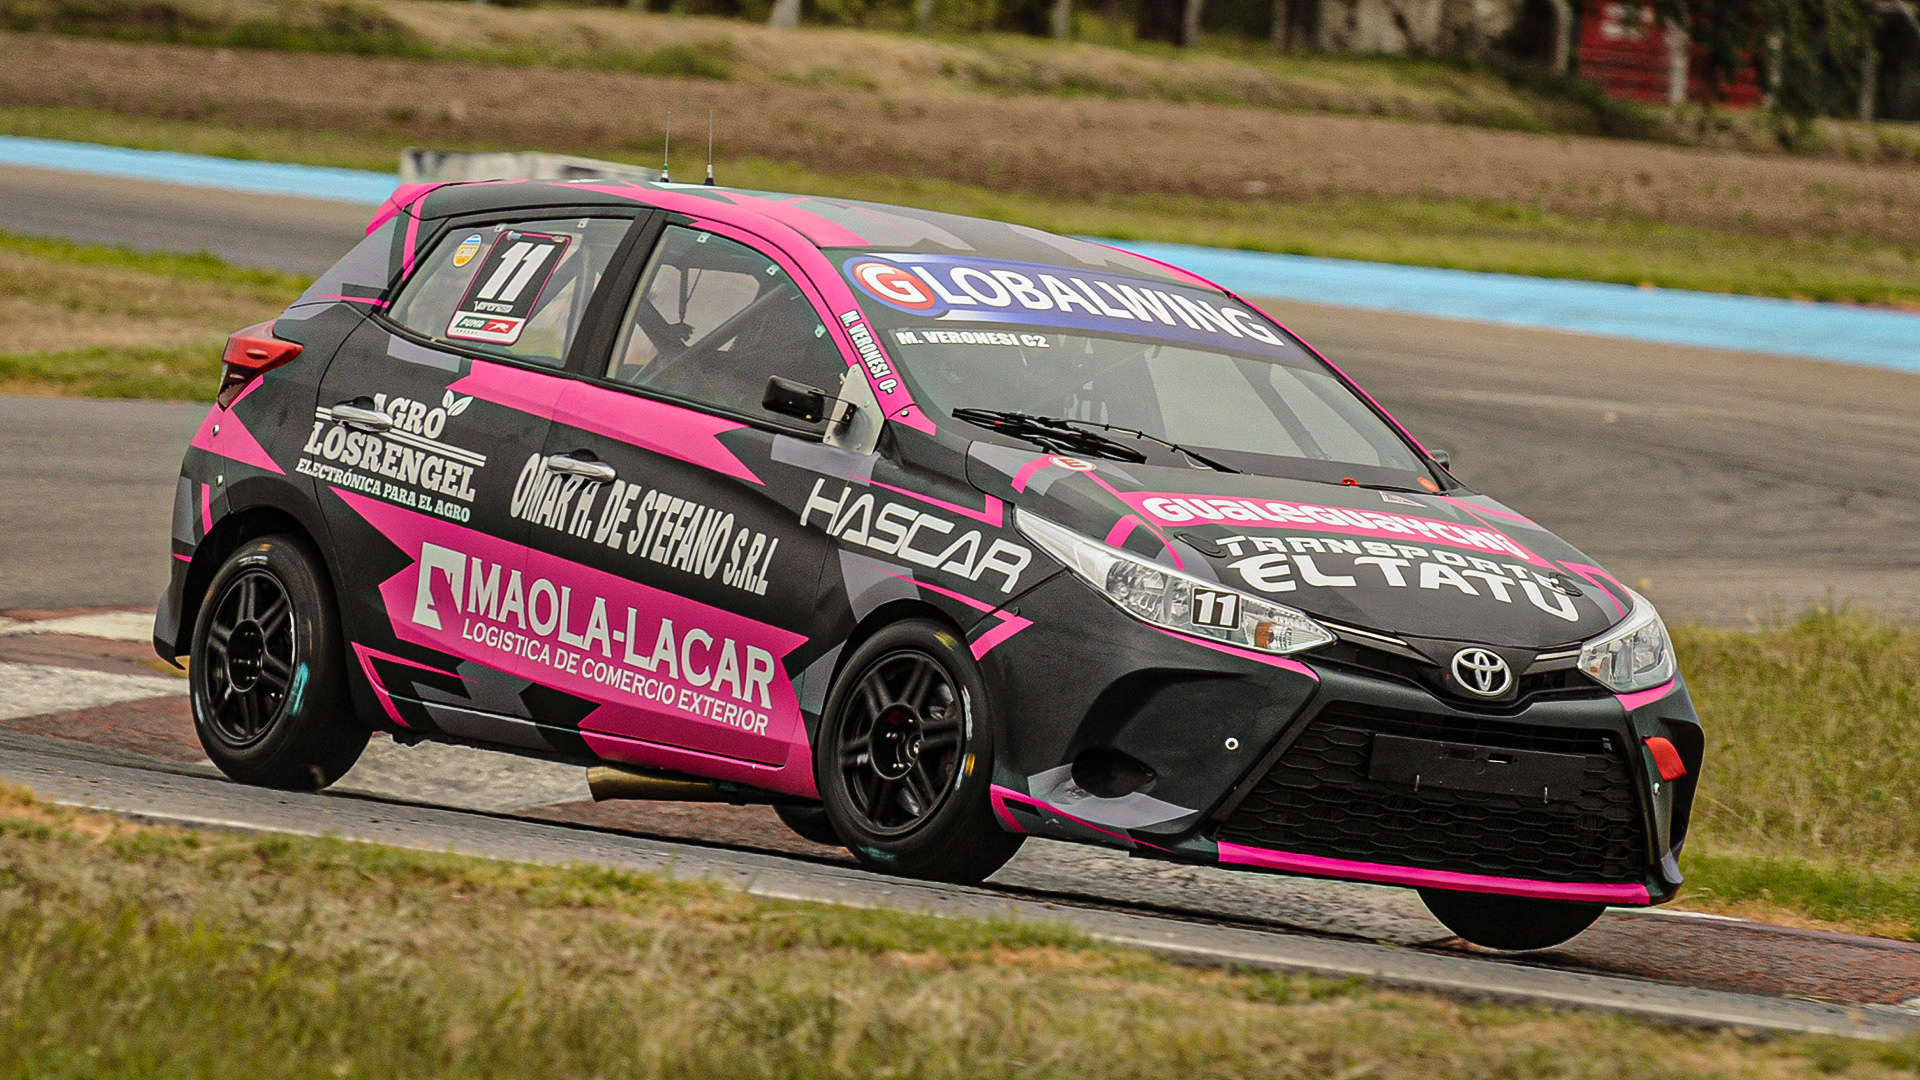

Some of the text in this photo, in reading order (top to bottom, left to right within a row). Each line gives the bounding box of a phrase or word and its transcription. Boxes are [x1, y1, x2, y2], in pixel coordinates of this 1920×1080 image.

[477, 241, 555, 302] 11
[459, 318, 486, 329] PUMA
[839, 310, 862, 328] M.
[861, 263, 1285, 347] GLOBALWING
[848, 322, 892, 380] VERONESI
[895, 331, 1050, 348] M. VERONESI C2
[295, 458, 471, 523] ELECTRÓNICA PARA EL AGRO
[303, 421, 476, 502] LOSRENGEL
[510, 452, 586, 532] OMAR
[568, 480, 600, 539] H.
[593, 479, 642, 549] DE
[626, 489, 735, 579] STEFANO
[800, 478, 1033, 594] HASCAR
[1216, 535, 1566, 596] TRANSPORTE
[1226, 553, 1357, 593] EL
[467, 556, 775, 710] MAOLA-LACAR
[1196, 592, 1237, 627] 11
[462, 618, 769, 736] LOGISTICA DE COMERCIO EXTERIOR
